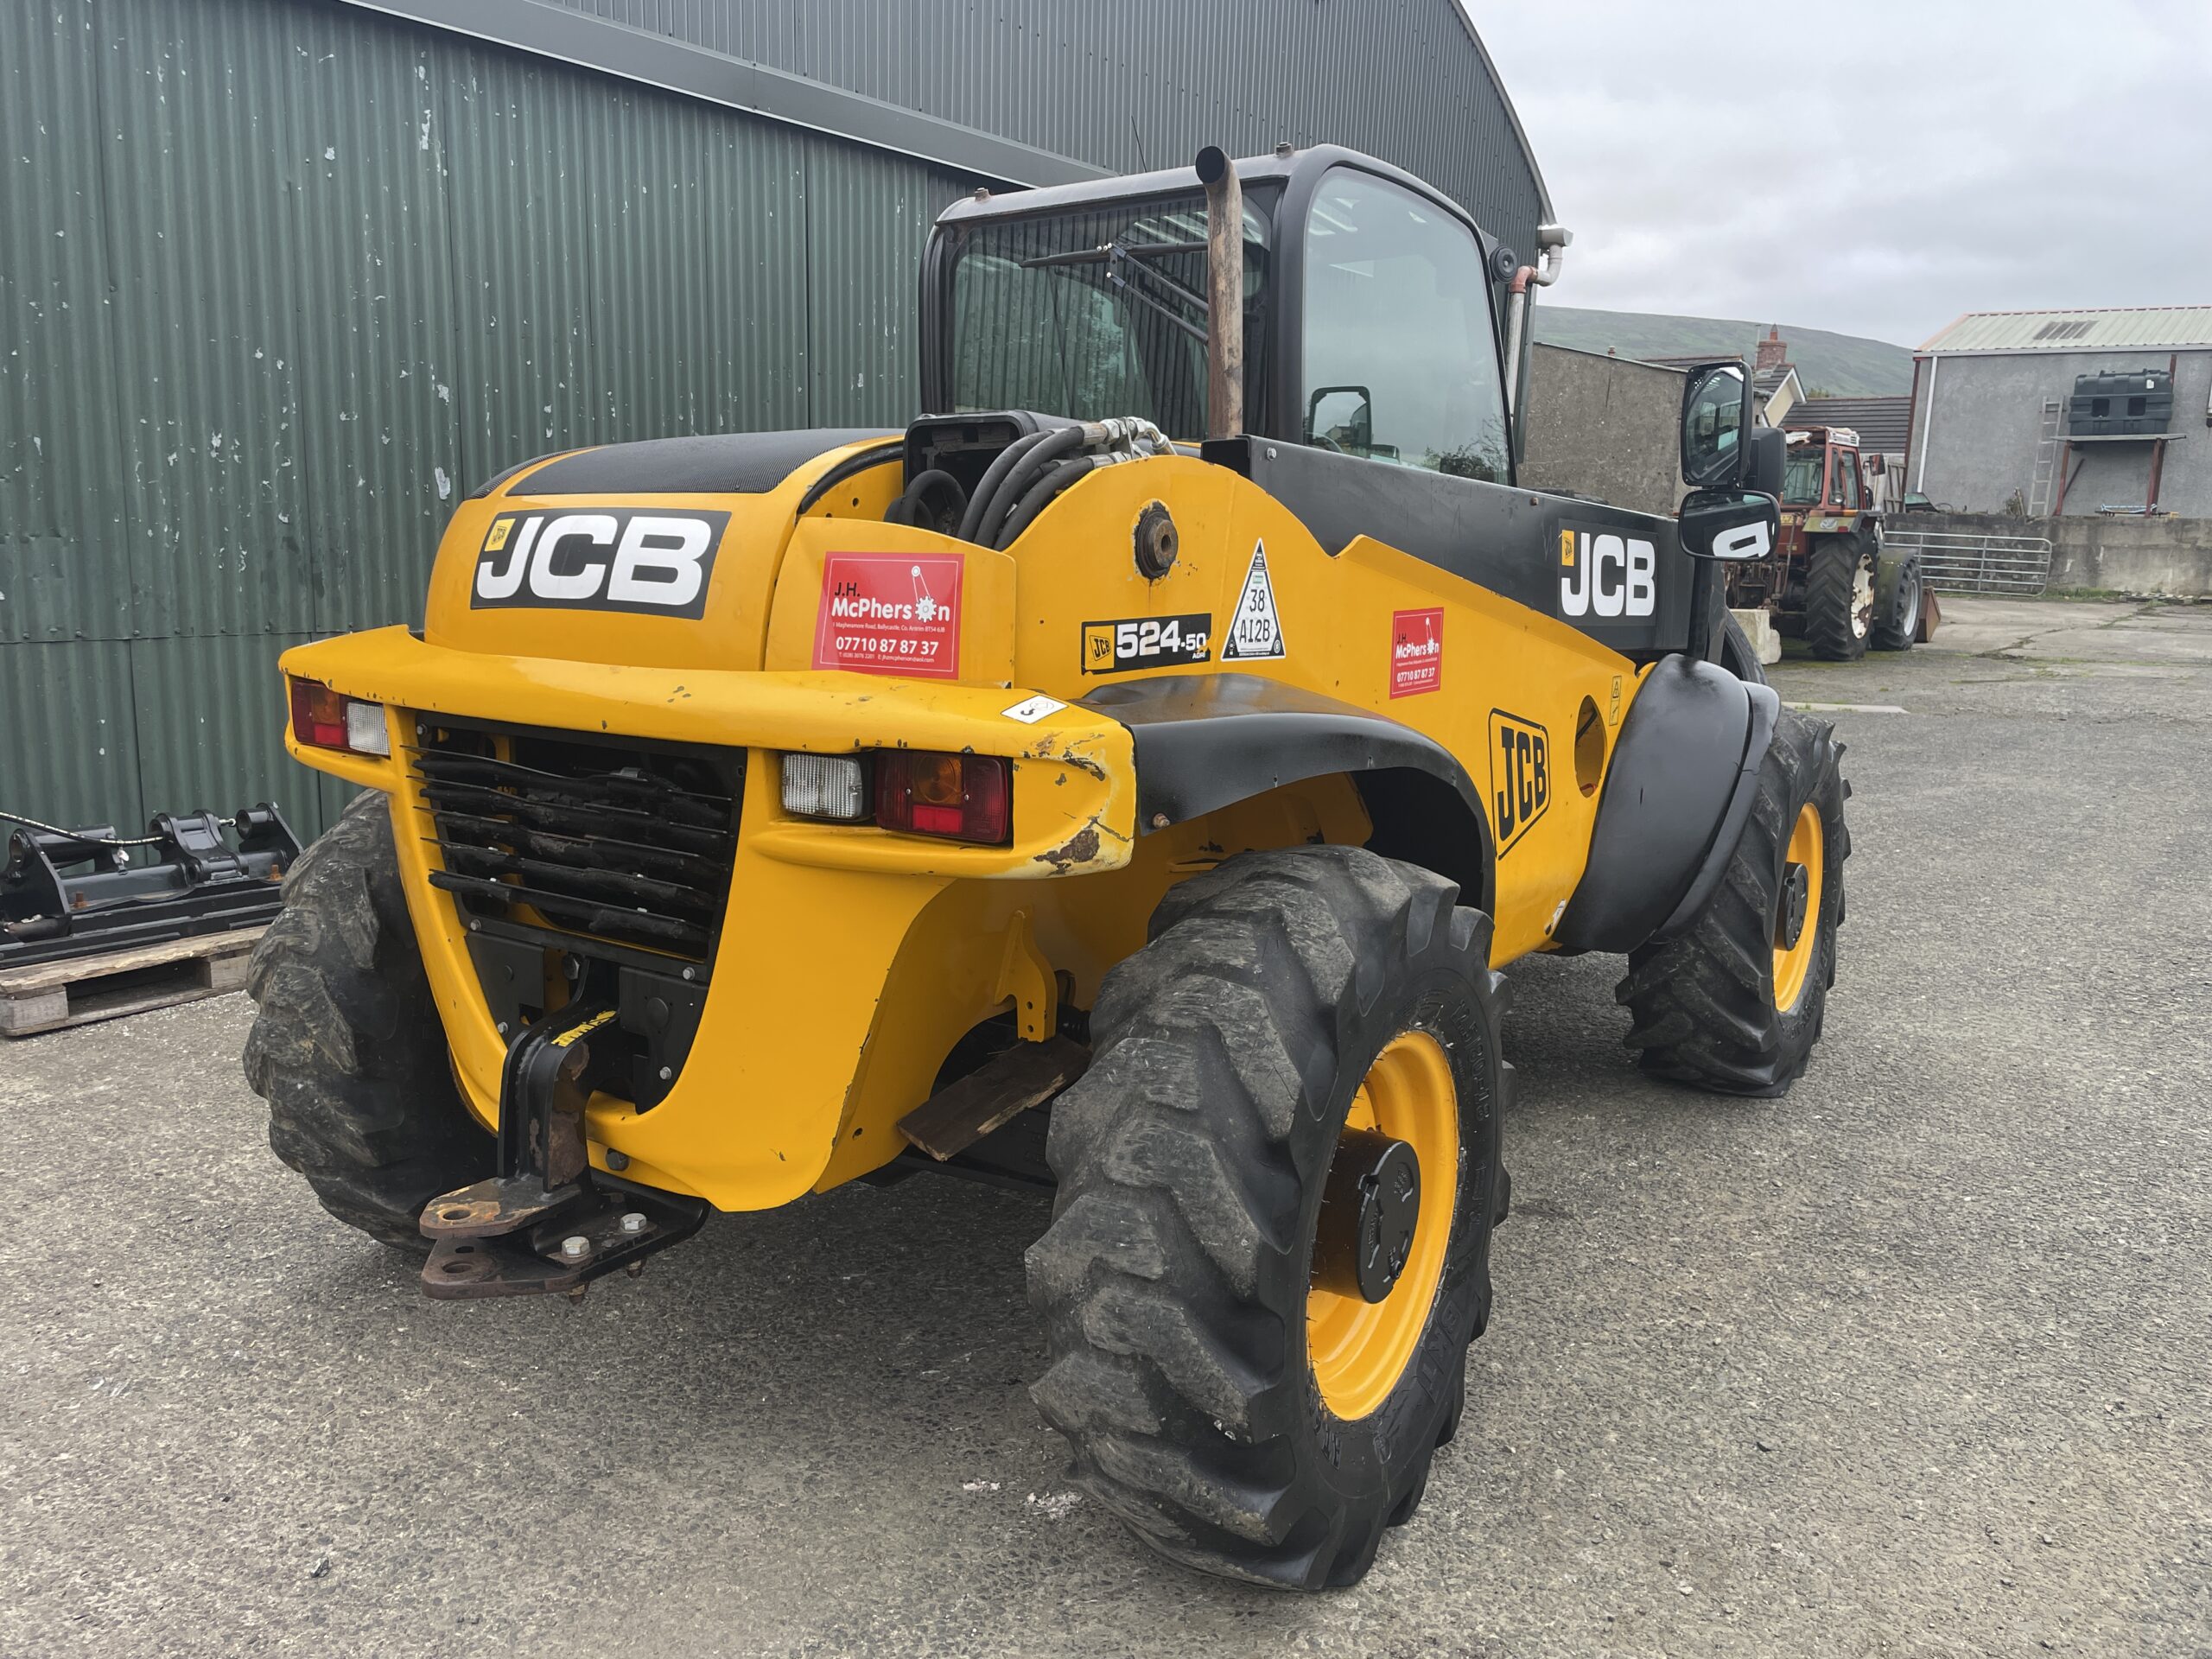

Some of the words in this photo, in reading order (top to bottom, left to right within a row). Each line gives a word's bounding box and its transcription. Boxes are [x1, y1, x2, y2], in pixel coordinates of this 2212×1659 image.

[476, 514, 712, 607] JCB
[1560, 532, 1656, 617] JCB
[834, 582, 861, 597] J.H.
[1249, 589, 1265, 613] 38
[831, 596, 950, 623] McPherson
[836, 636, 877, 652] 07710
[879, 638, 898, 653] 87
[899, 639, 918, 654] 87
[920, 640, 939, 655] 37
[1093, 638, 1110, 657] JCB
[1396, 671, 1414, 683] 07710
[1414, 670, 1421, 680] 87
[1421, 668, 1428, 678] 87
[1428, 666, 1435, 677] 37
[1497, 726, 1547, 842] JCB
